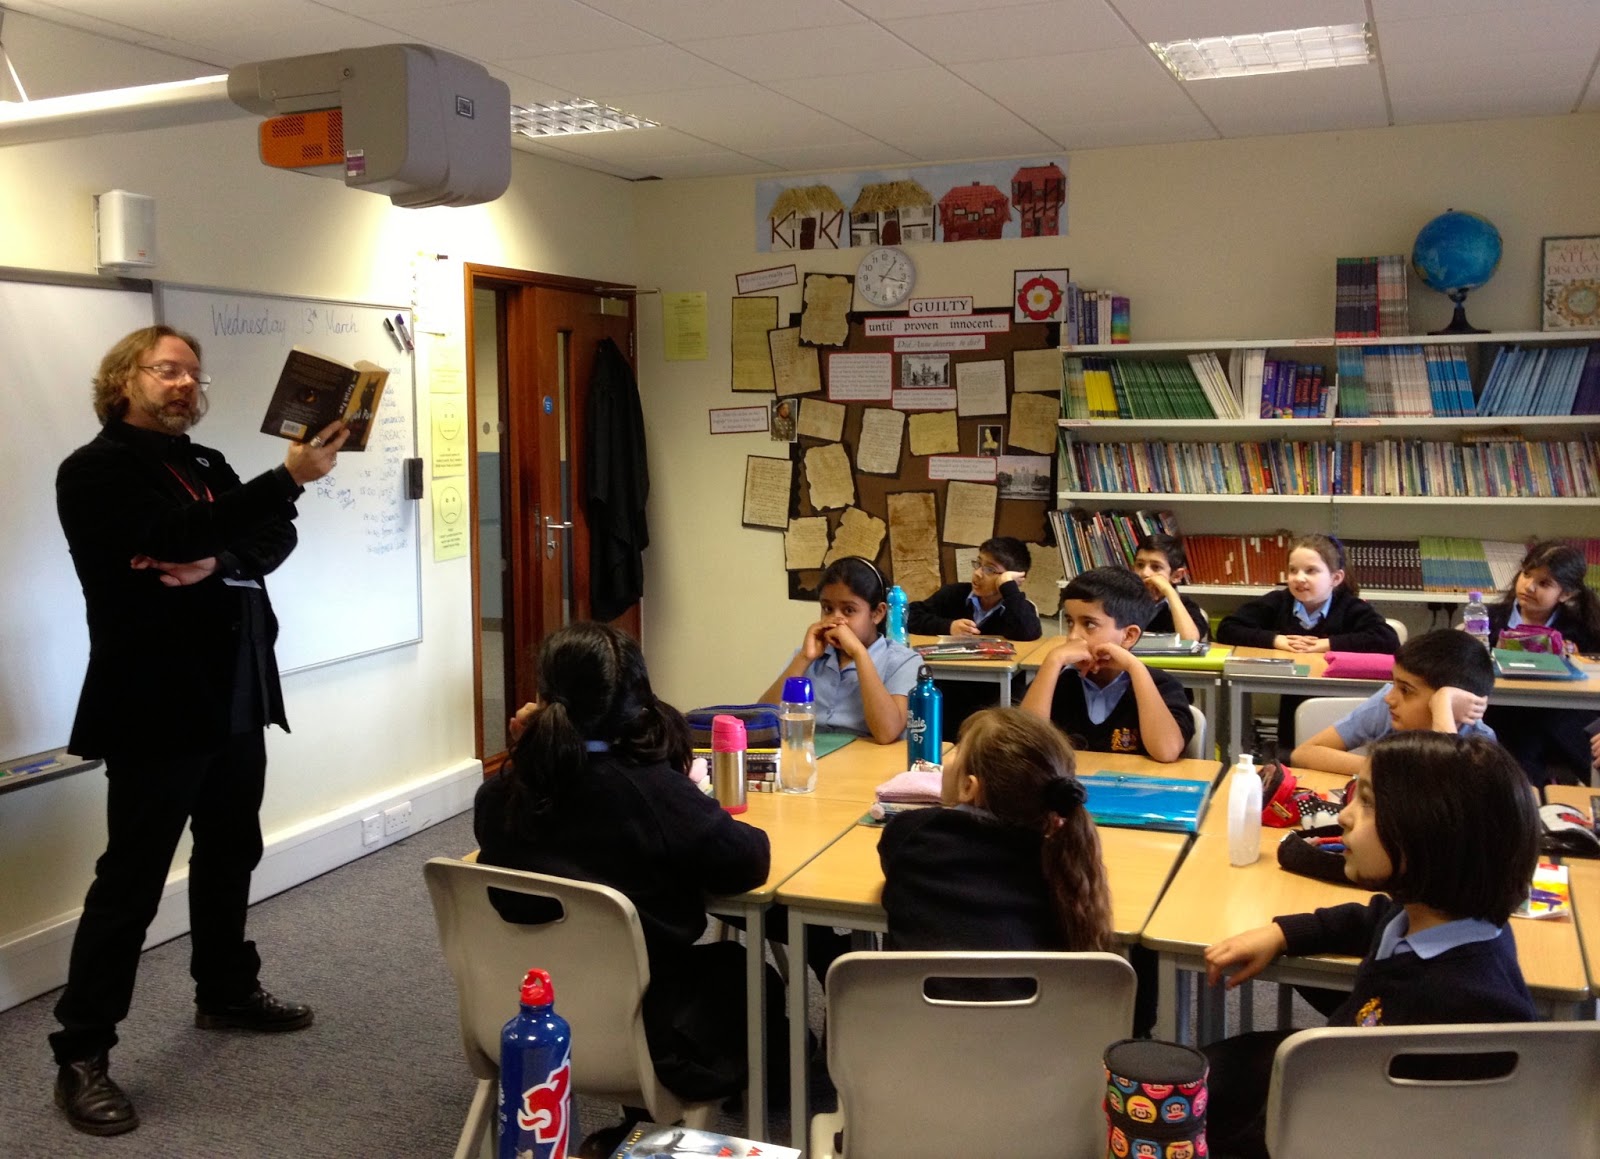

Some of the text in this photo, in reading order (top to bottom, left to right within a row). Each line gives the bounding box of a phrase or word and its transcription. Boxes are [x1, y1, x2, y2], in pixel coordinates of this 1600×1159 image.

[913, 300, 969, 313] GUILTY
[211, 303, 286, 345] Wednesday
[326, 309, 359, 335] March
[868, 320, 894, 332] until
[904, 320, 939, 332] proven
